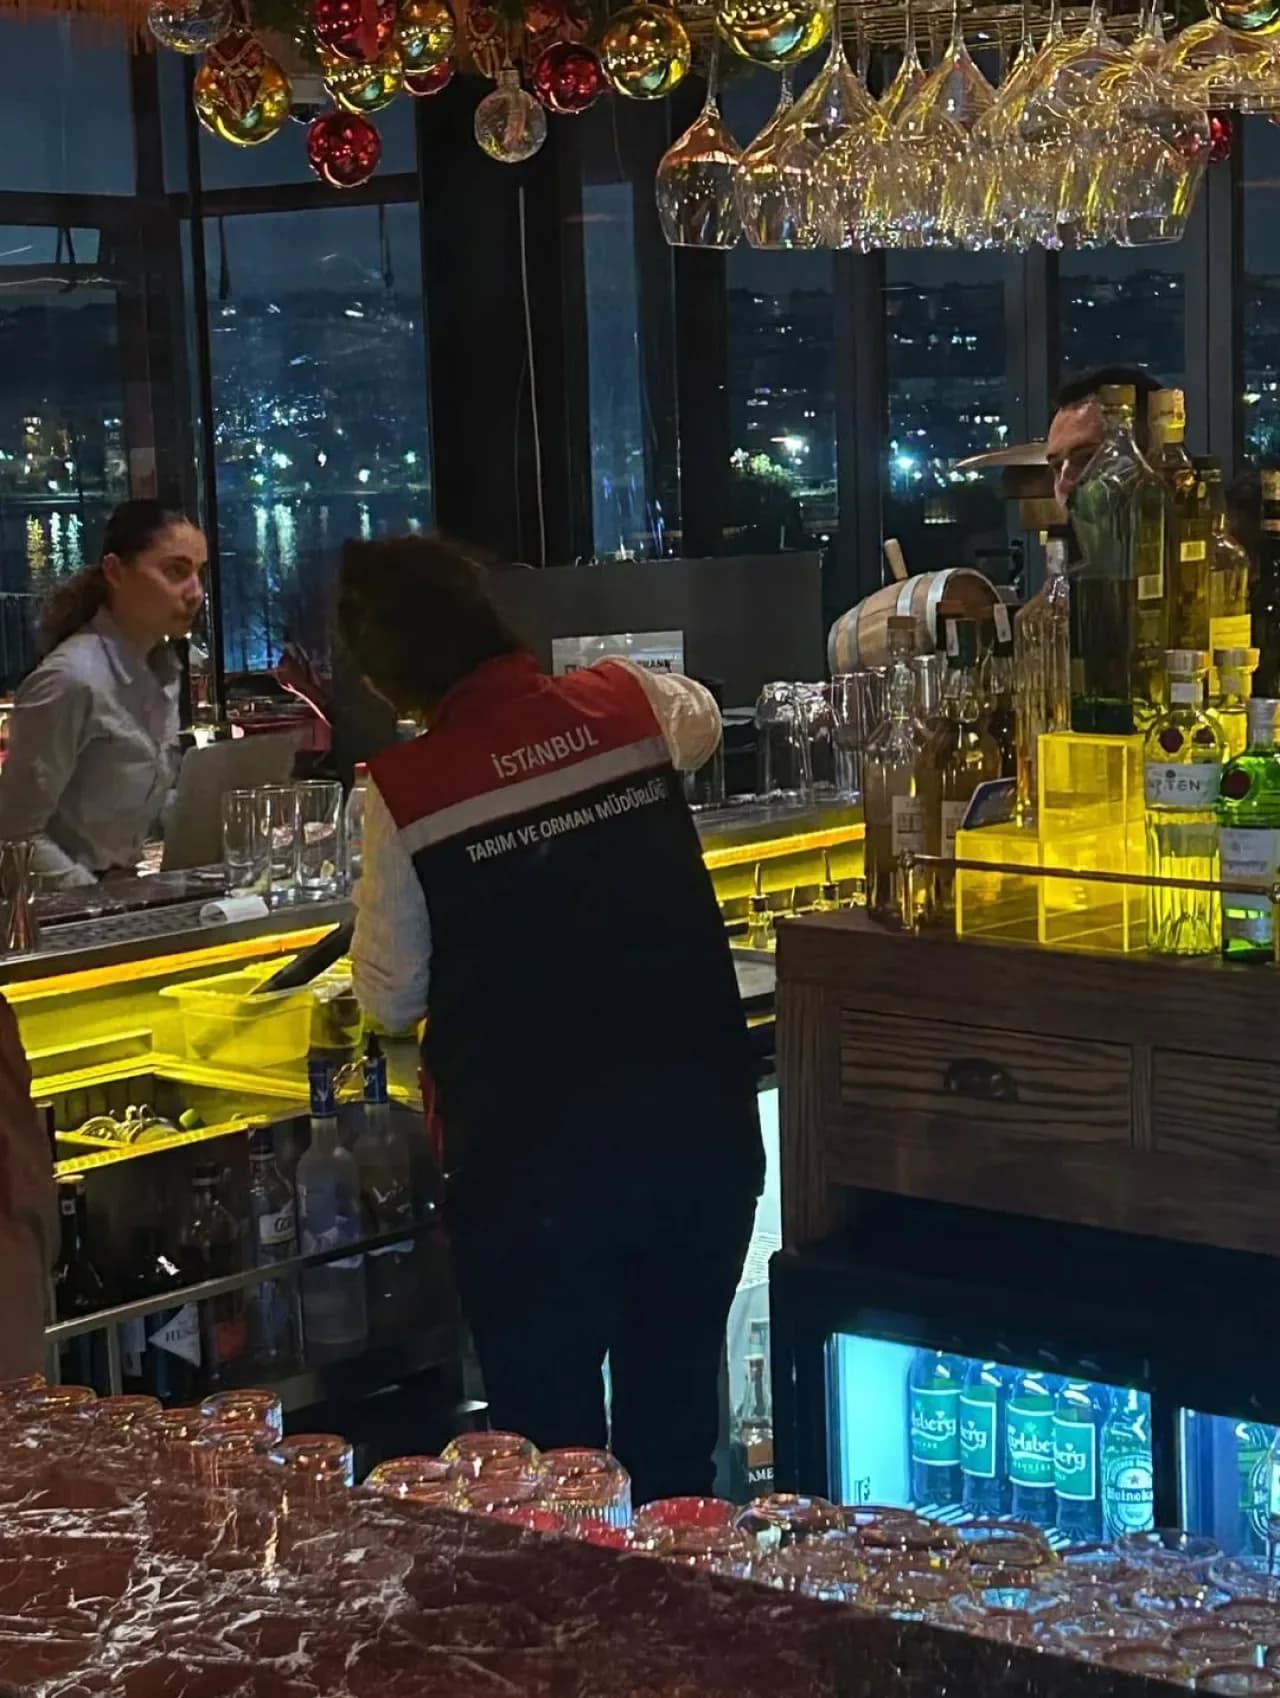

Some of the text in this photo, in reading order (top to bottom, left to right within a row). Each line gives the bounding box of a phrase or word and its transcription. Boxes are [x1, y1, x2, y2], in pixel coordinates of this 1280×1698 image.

[491, 724, 600, 779] İSTANBUL
[466, 831, 517, 864] TARIM
[517, 824, 540, 846] VE
[540, 807, 595, 838] ORMAN
